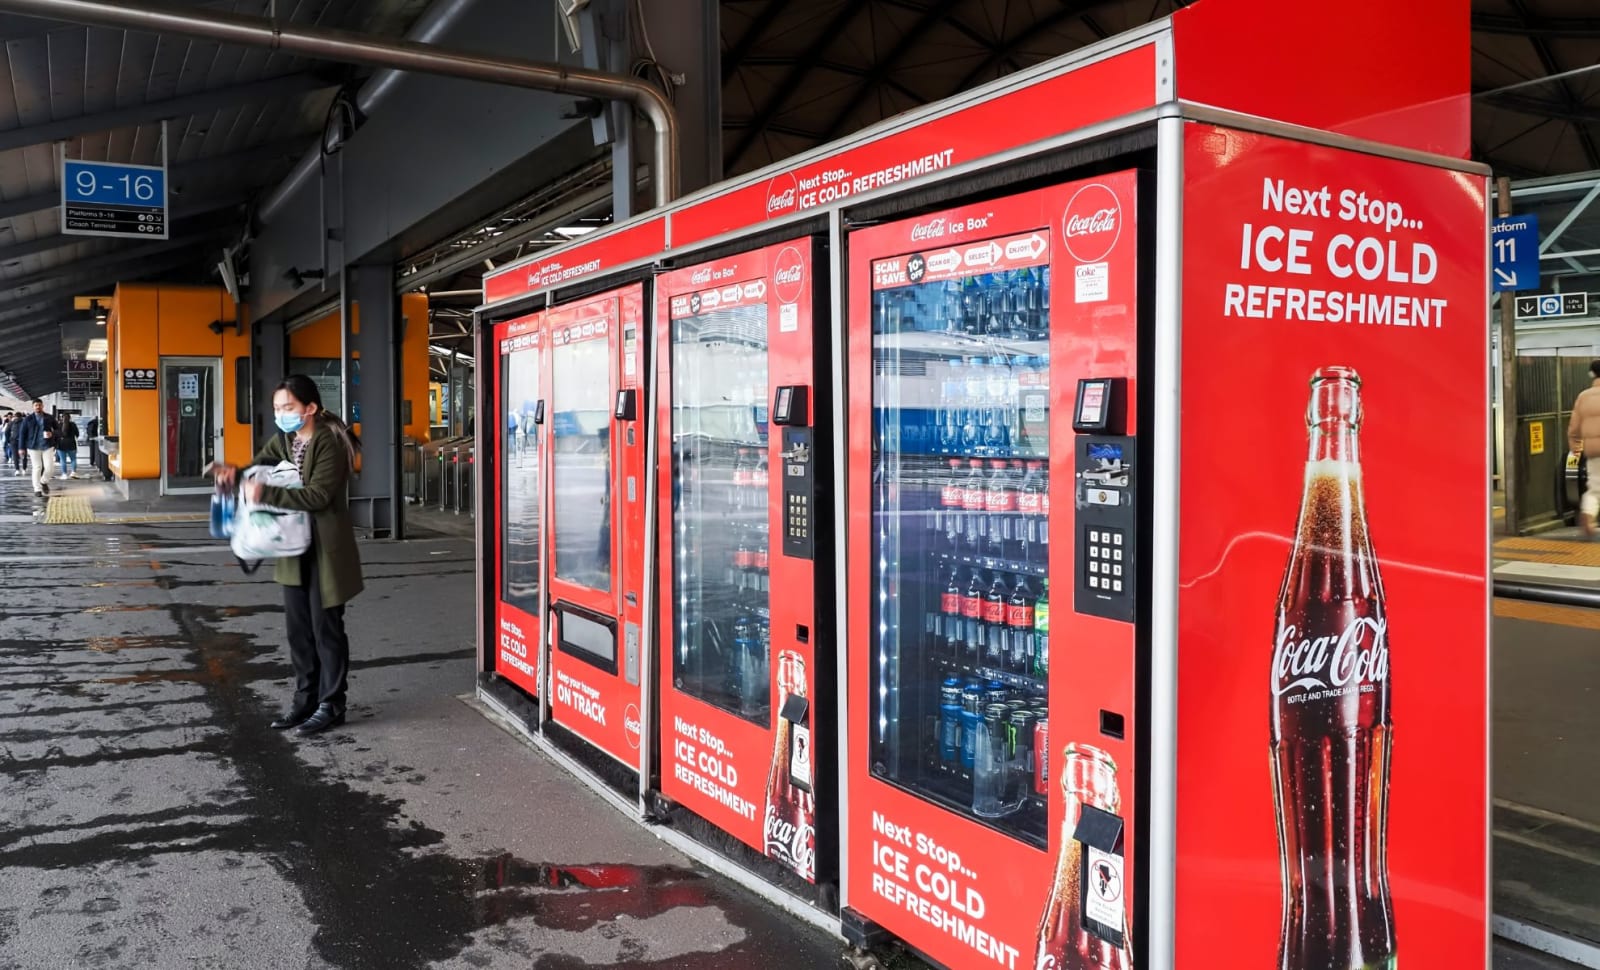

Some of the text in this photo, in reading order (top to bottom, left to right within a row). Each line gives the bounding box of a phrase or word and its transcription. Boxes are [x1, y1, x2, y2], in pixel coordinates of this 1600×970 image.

[800, 148, 954, 209] ICE COLD REFRESHMENT
[800, 169, 852, 191] Next Stop...
[768, 188, 795, 212] Coca-Cola
[1262, 177, 1423, 232] Next Stop...
[911, 217, 947, 242] Coca-Cola
[949, 221, 964, 234] Ice
[1066, 207, 1119, 238] Coca-Cola
[1491, 221, 1527, 233] atform
[968, 251, 989, 260] SELECT
[1240, 223, 1438, 284] ICE COLD
[1494, 238, 1516, 263] 11
[550, 272, 562, 283] COLD
[563, 259, 601, 280] REFRESHMENT
[875, 261, 900, 274] SCAN
[882, 271, 906, 285] SAVE
[911, 269, 923, 280] OFF
[1224, 283, 1448, 328] REFRESHMENT
[501, 633, 527, 658] ICE COLD
[1271, 617, 1388, 696] Coca-Cola
[557, 684, 606, 726] ON TRACK
[1287, 693, 1307, 704] BOTTLE
[1308, 691, 1321, 700] AND
[1322, 688, 1342, 698] TRADE
[674, 715, 733, 759] Next Stop...
[674, 739, 738, 788] ICE COLD
[674, 762, 757, 822] REFRESHMENT
[872, 811, 978, 881] Next Stop...
[872, 840, 986, 920] ICE COLD
[872, 872, 1020, 970] REFRESHMENT
